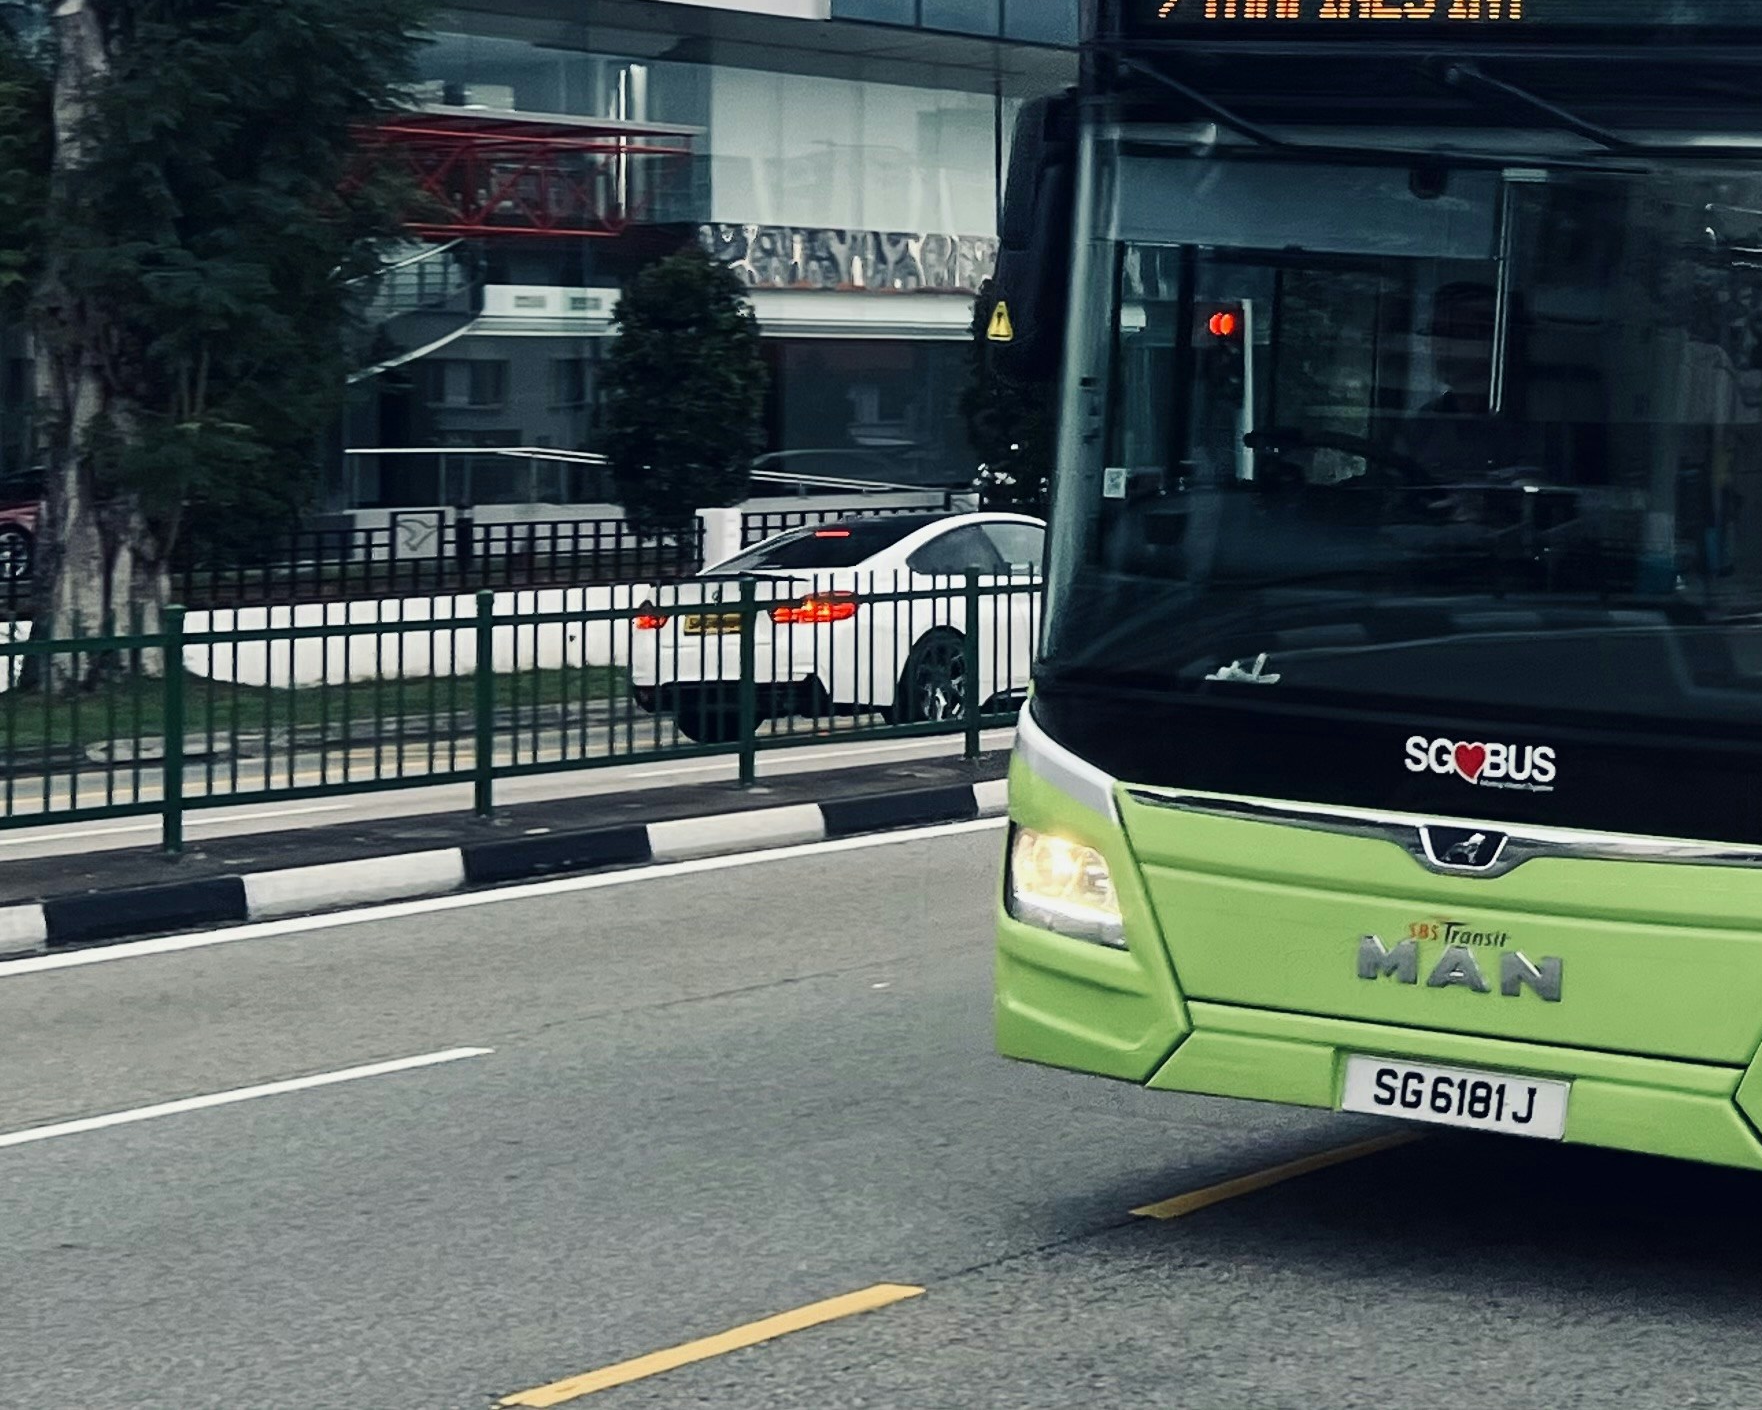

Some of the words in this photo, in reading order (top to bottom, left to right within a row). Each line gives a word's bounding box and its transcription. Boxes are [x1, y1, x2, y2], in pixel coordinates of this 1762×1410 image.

[1409, 922, 1439, 941] SBS
[1442, 921, 1510, 948] Transit
[1358, 934, 1563, 1002] MAN
